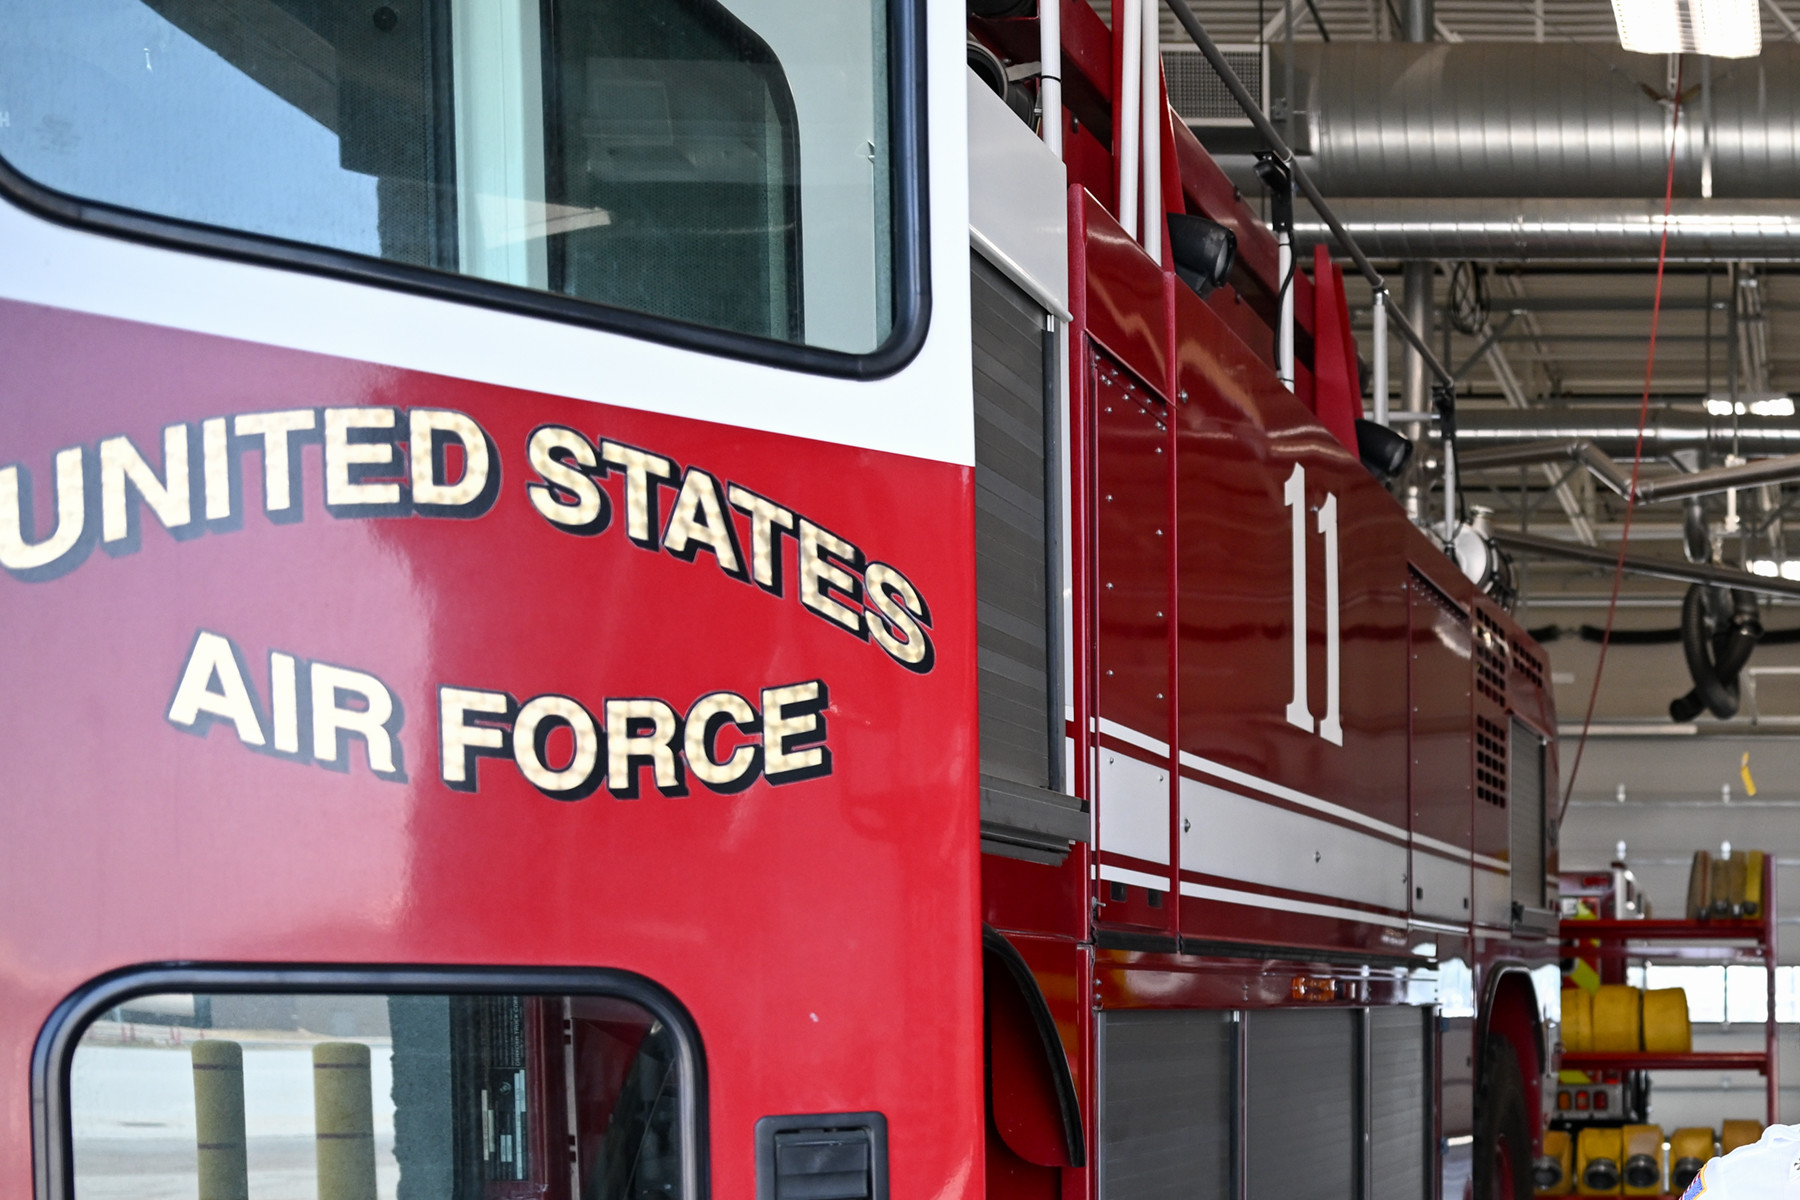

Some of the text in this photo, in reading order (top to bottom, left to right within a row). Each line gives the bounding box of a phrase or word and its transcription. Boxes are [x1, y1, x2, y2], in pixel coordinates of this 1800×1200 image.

[0, 407, 934, 673] UNITED STATES
[1284, 462, 1343, 747] 11
[165, 629, 832, 800] AIR FORCE
